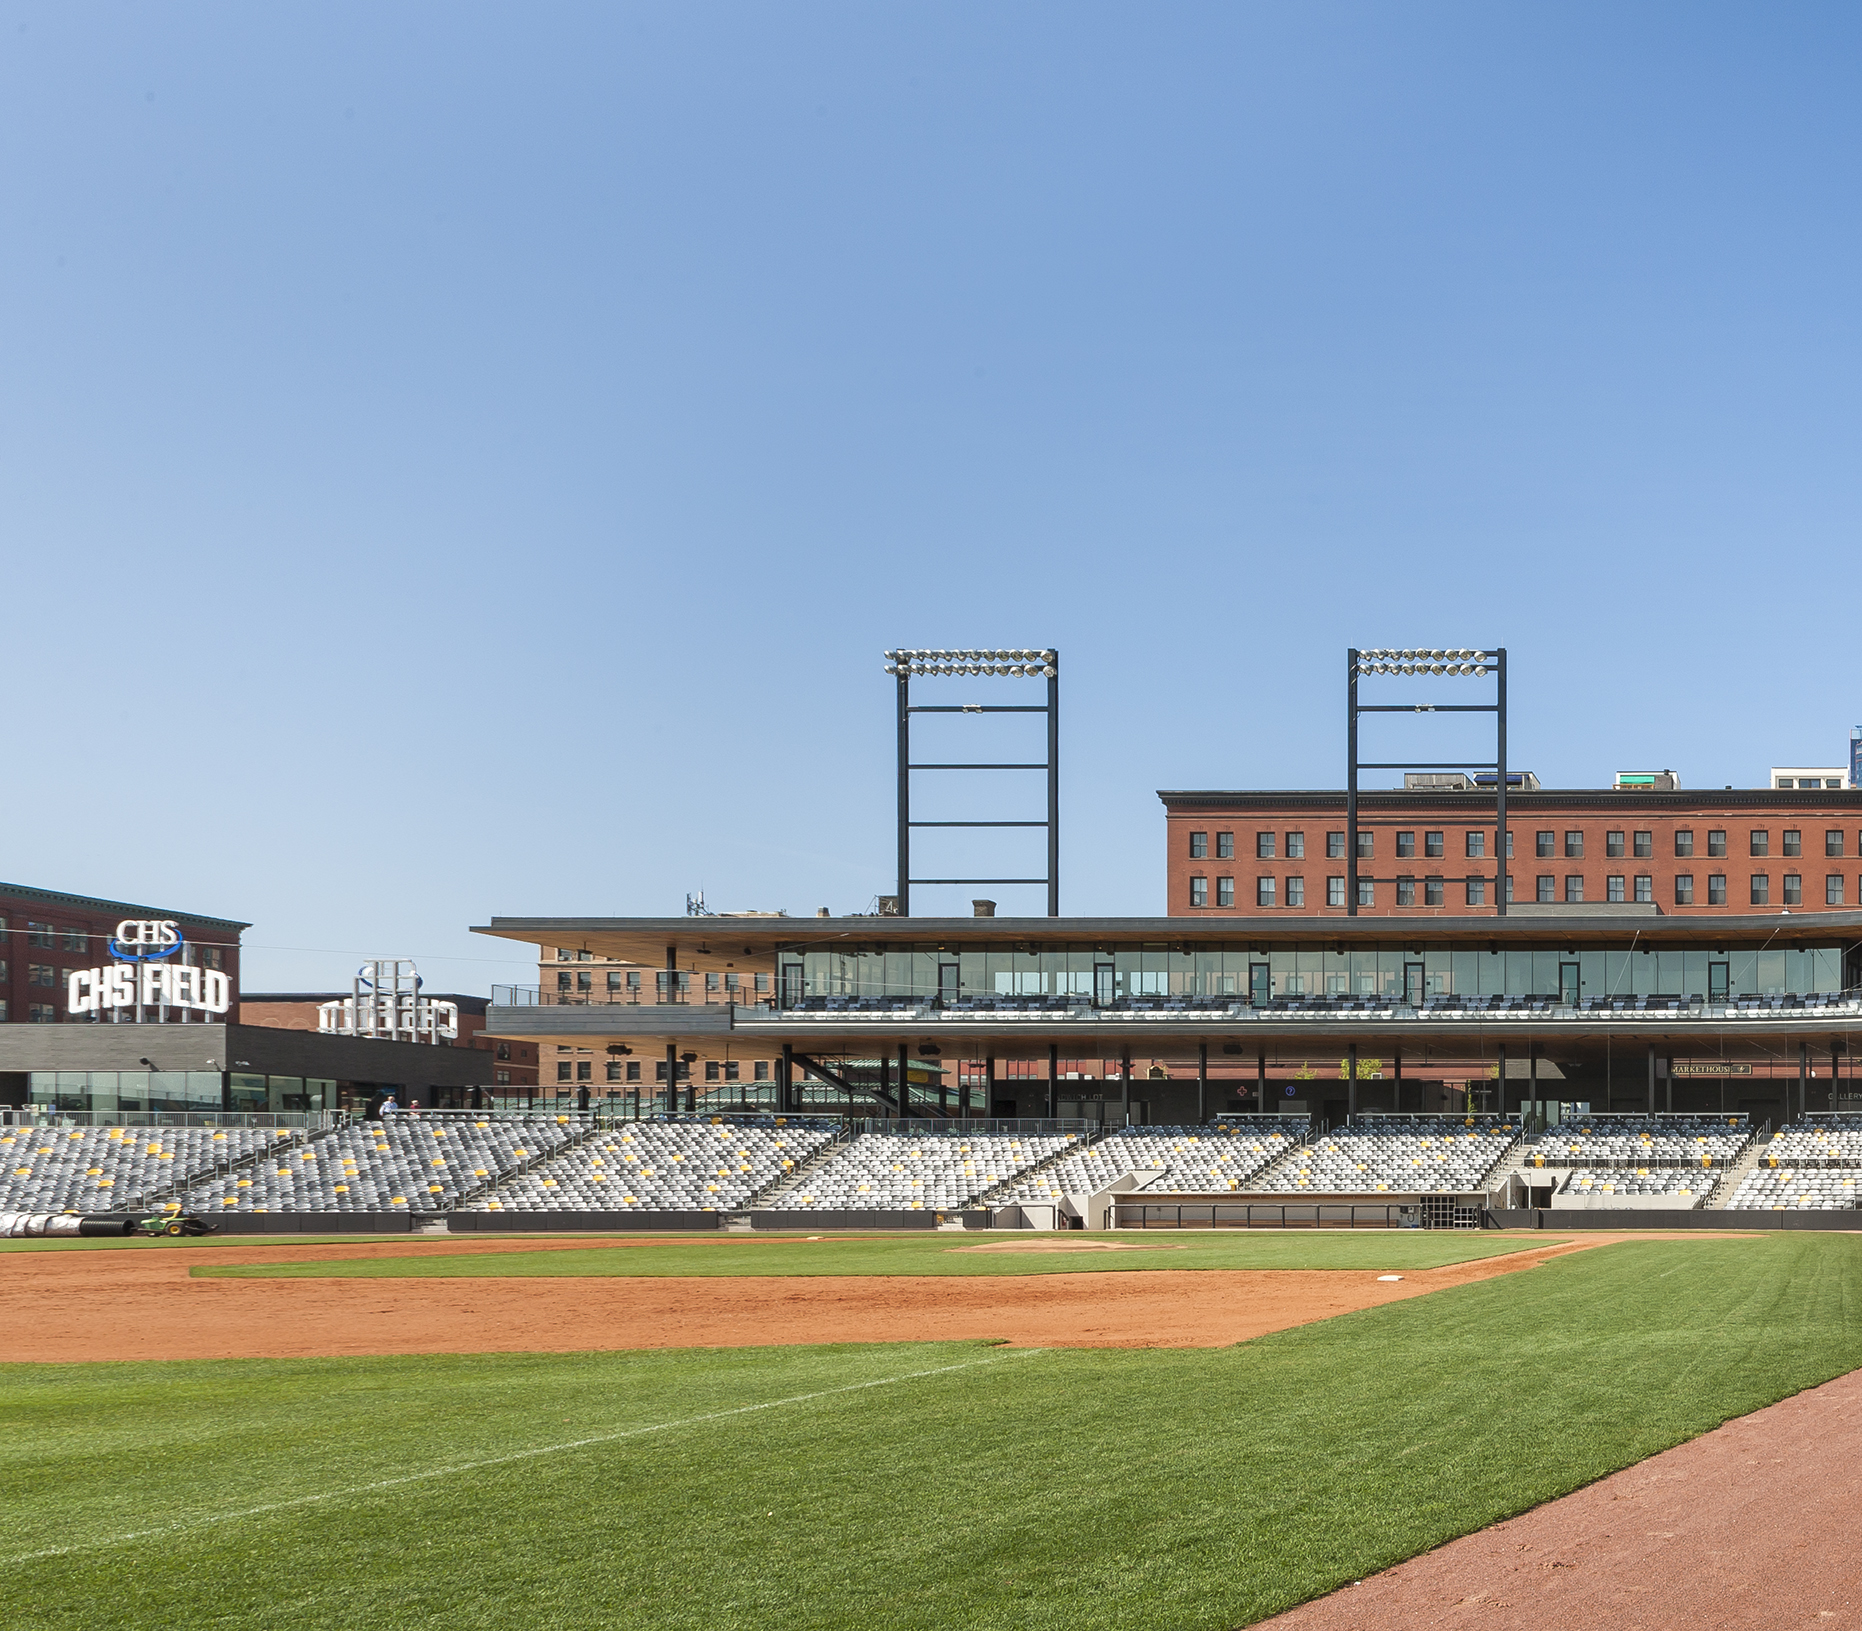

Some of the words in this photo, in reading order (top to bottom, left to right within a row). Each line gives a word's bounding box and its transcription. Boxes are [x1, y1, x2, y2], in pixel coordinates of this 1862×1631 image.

[116, 919, 179, 945] CHS
[68, 964, 134, 1014] CHS
[142, 962, 229, 1014] FIELD
[1044, 1093, 1087, 1101] SDWICH
